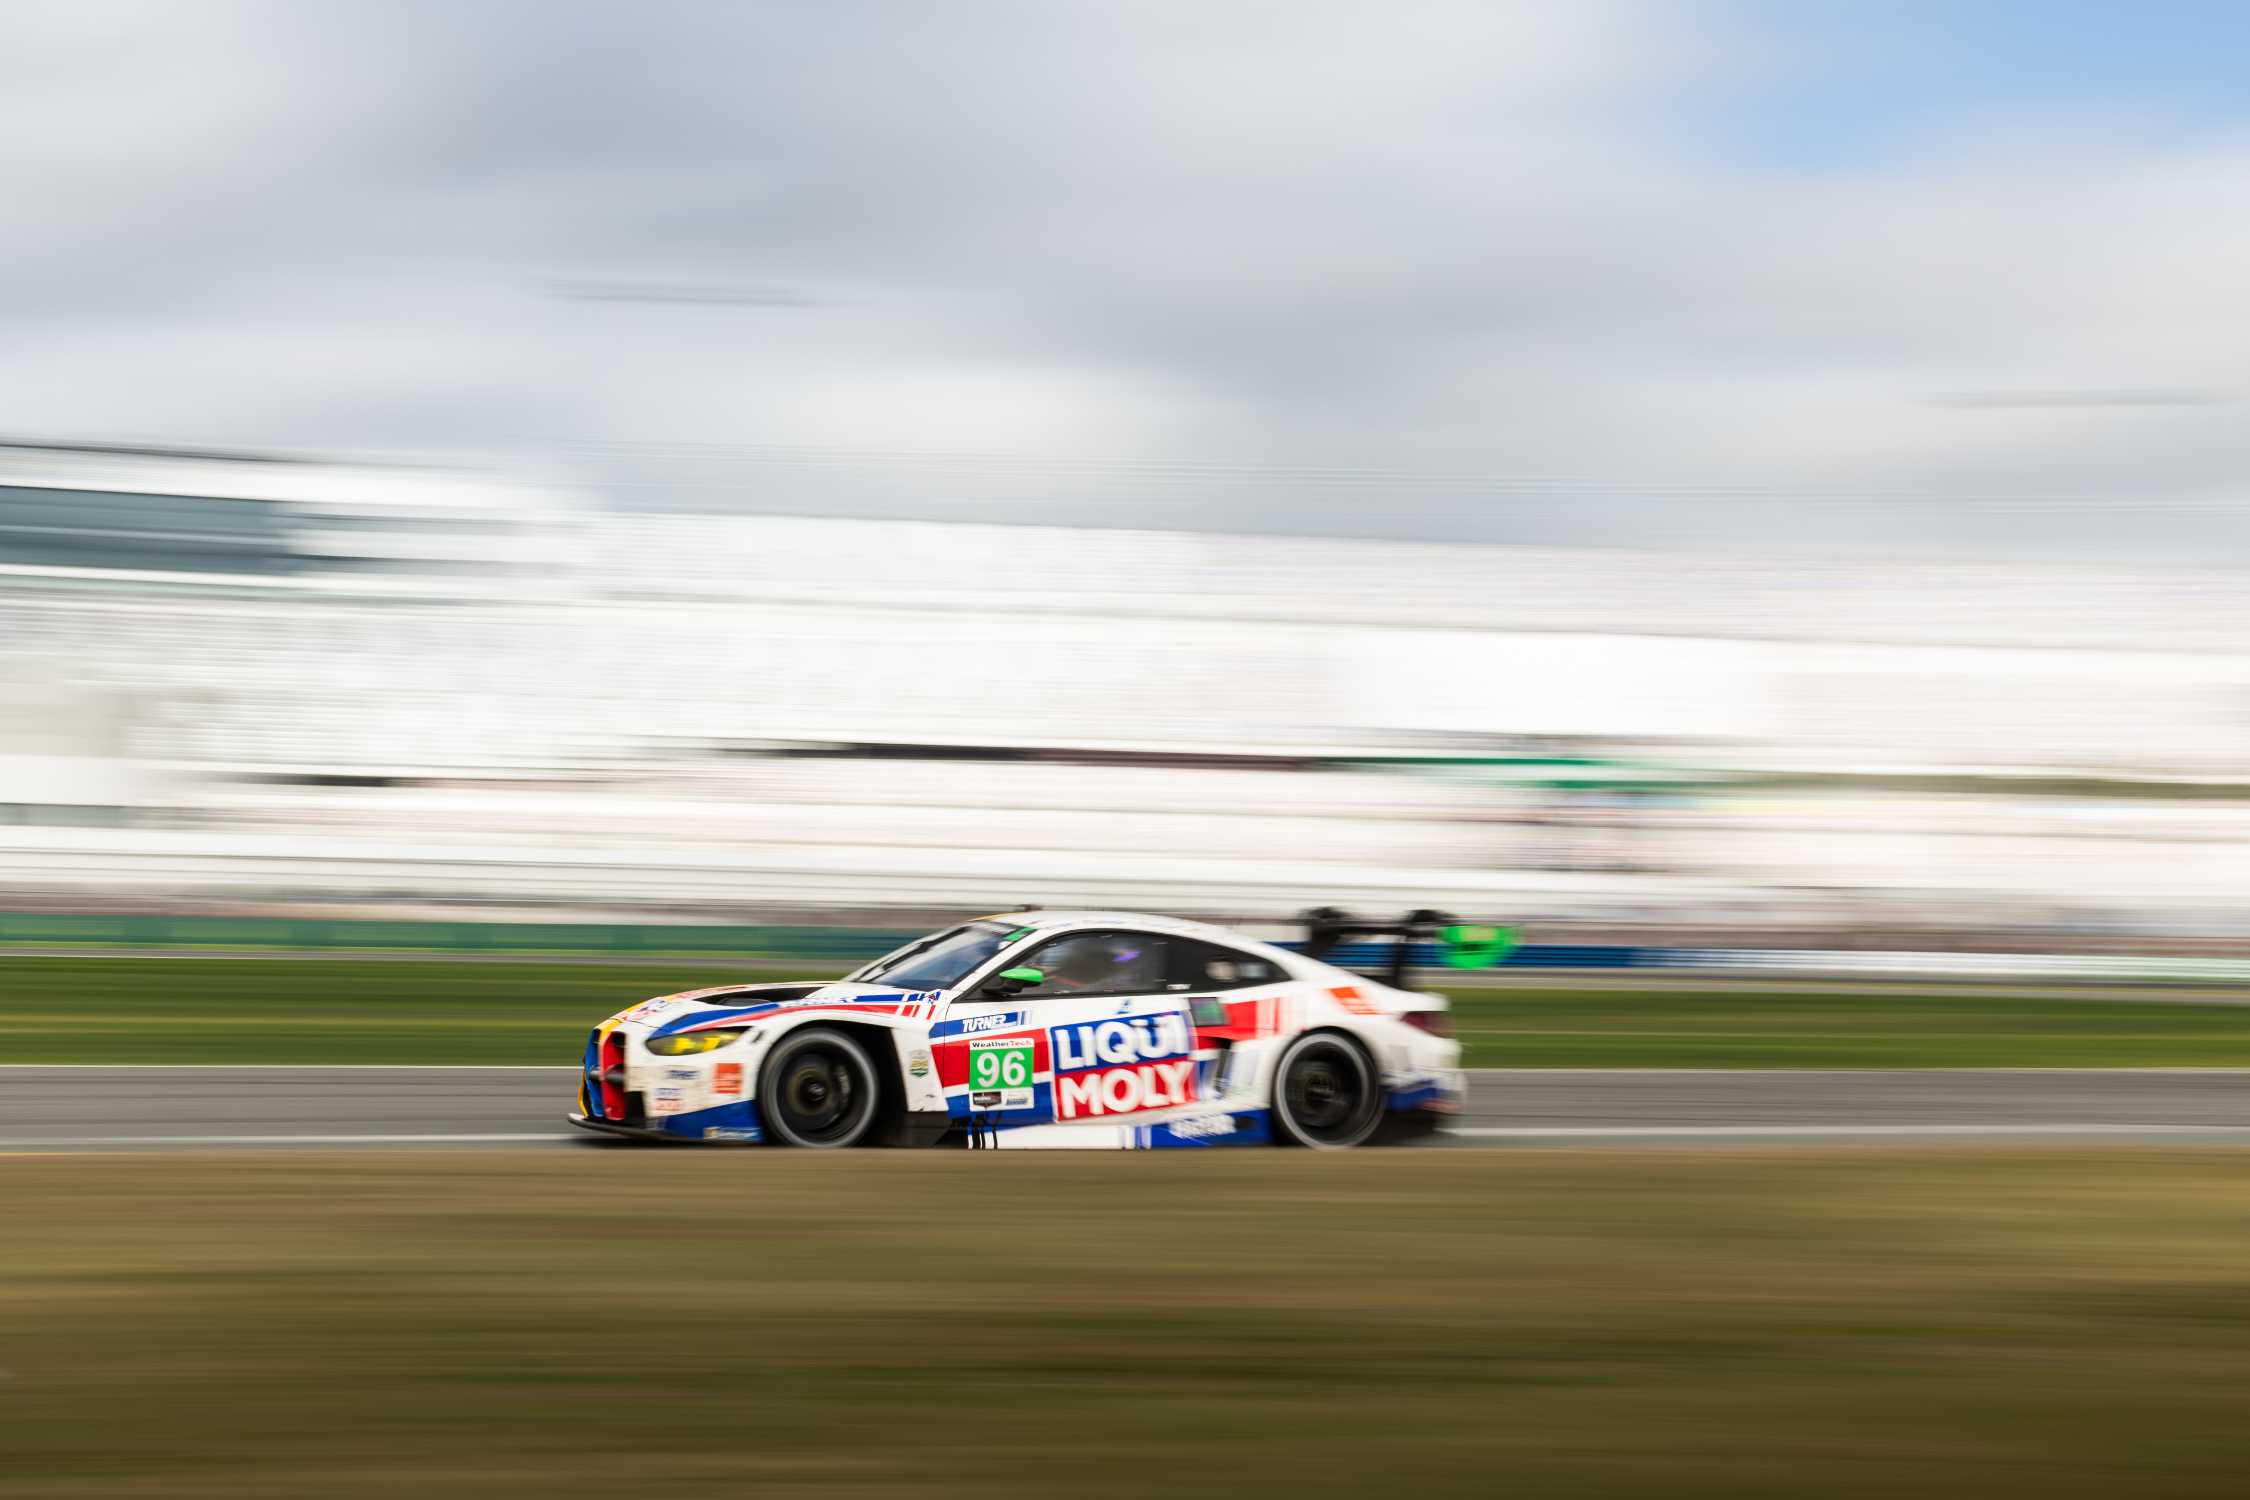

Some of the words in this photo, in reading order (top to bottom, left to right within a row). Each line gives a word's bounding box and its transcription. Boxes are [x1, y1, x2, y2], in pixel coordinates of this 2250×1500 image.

[962, 1014, 1007, 1033] TURNER
[972, 1039, 1031, 1049] WeatherTech
[977, 1051, 1026, 1087] 96
[1060, 1061, 1195, 1119] MOLY
